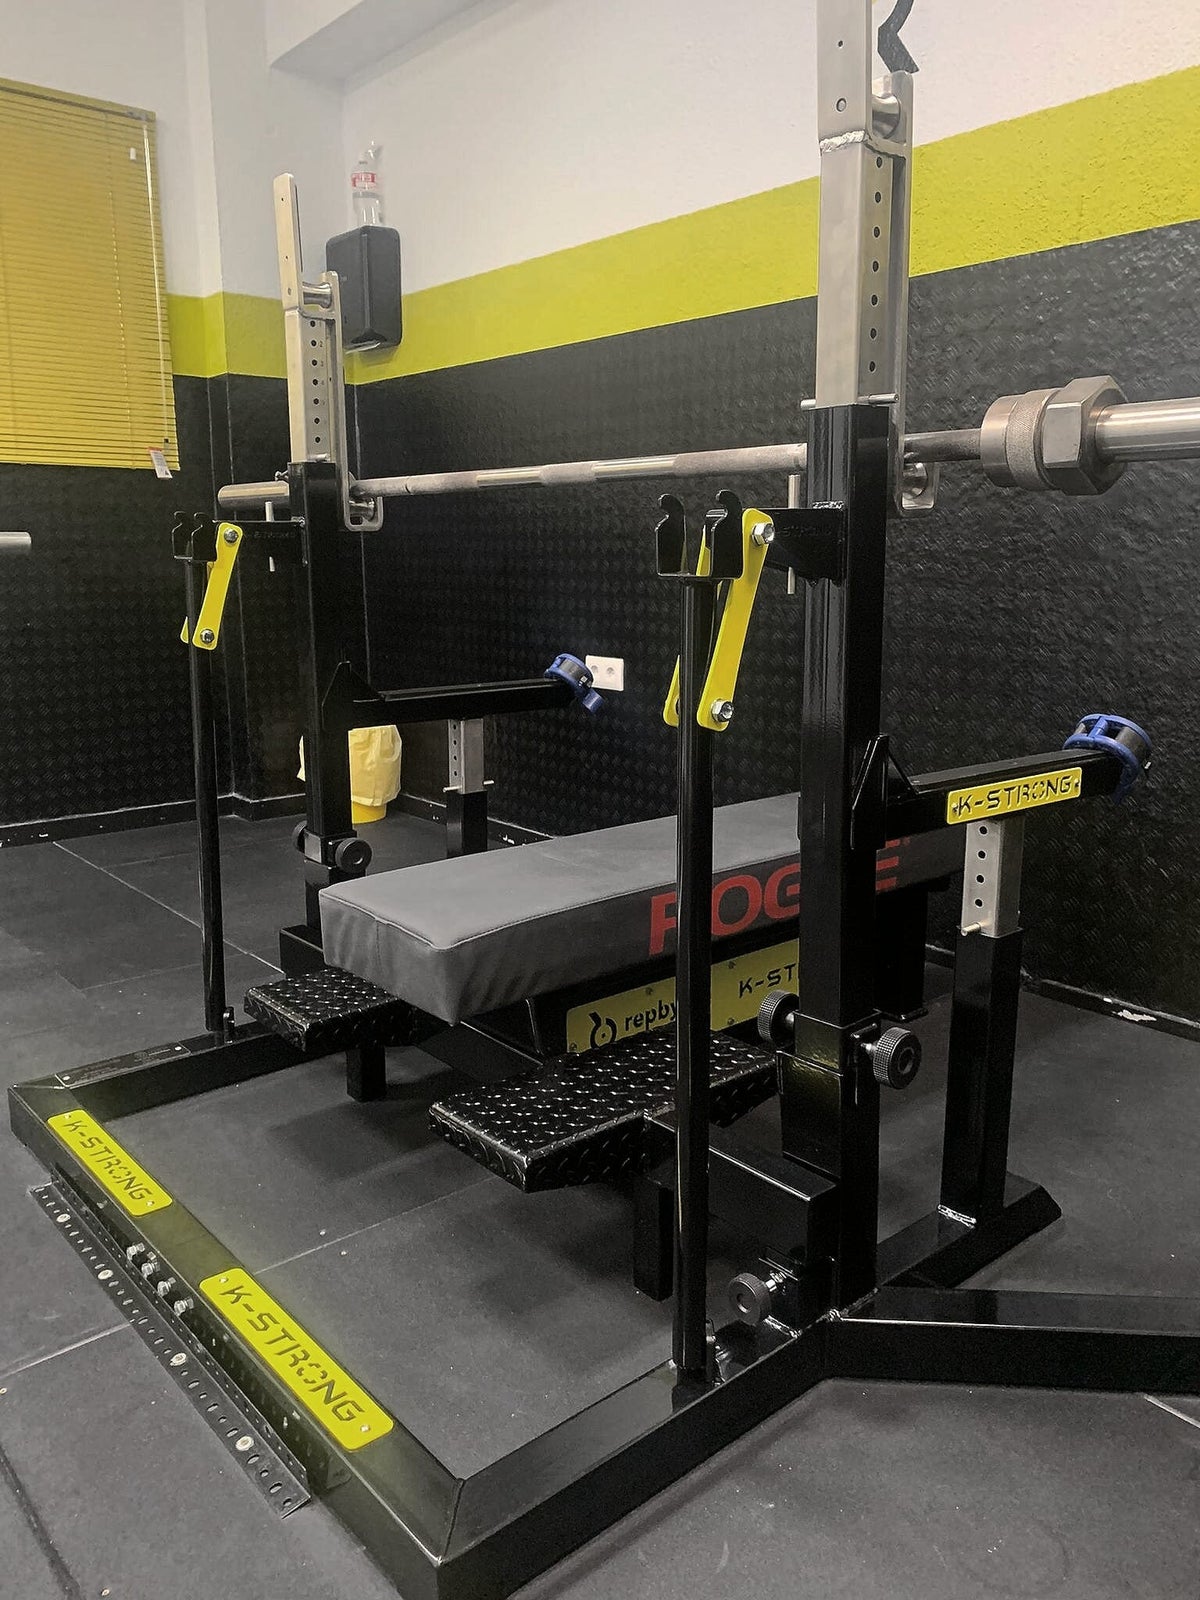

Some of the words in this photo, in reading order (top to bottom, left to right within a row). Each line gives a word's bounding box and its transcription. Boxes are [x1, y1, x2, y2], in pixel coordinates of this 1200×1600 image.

[958, 775, 1071, 816] K-STRONG
[649, 839, 900, 957] ROG
[739, 963, 799, 998] K-ST
[63, 1120, 153, 1200] K-STRONG
[219, 1285, 365, 1422] K-STRONG
